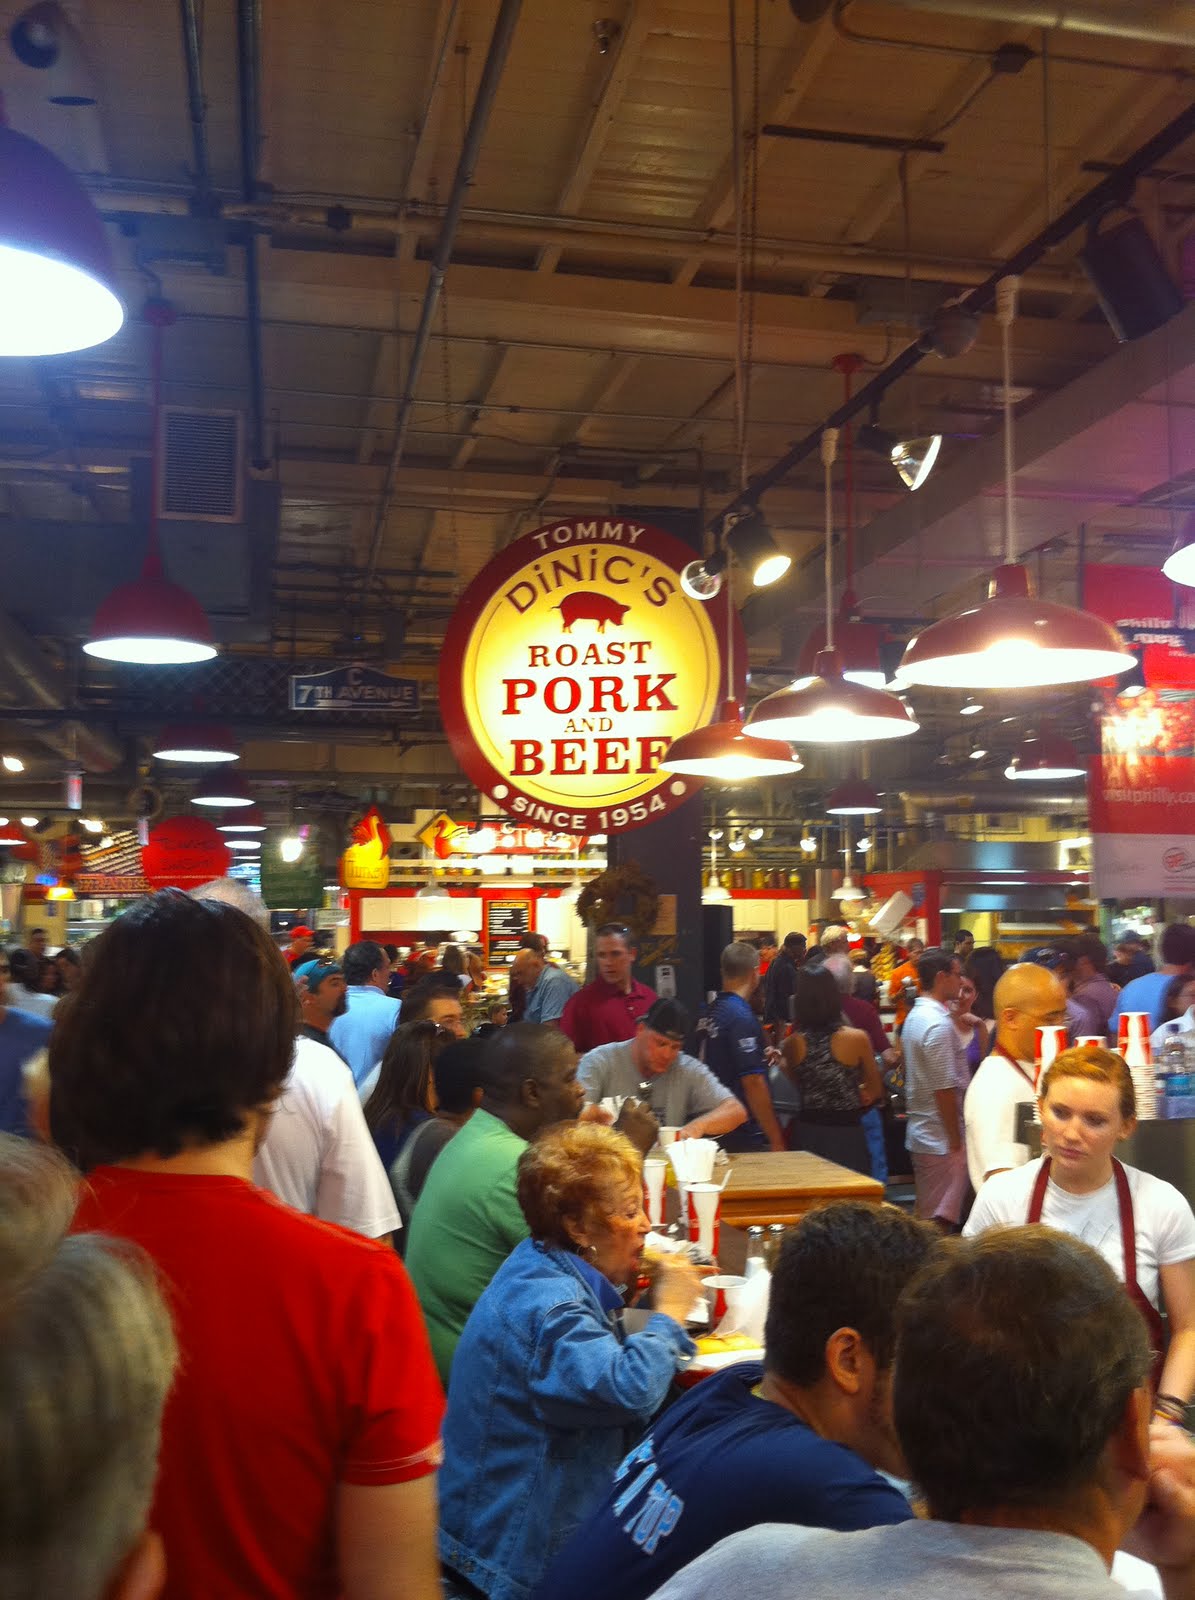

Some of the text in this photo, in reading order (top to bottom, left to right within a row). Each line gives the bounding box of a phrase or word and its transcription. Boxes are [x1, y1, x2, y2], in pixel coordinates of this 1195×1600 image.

[534, 522, 647, 549] TOMMY
[528, 641, 652, 667] ROAST
[347, 668, 362, 685] C
[296, 685, 414, 704] 7TH AVENUE
[502, 673, 678, 715] PORK
[564, 717, 613, 733] AND
[510, 736, 673, 776] BEEF
[511, 793, 666, 830] SINCE 1954
